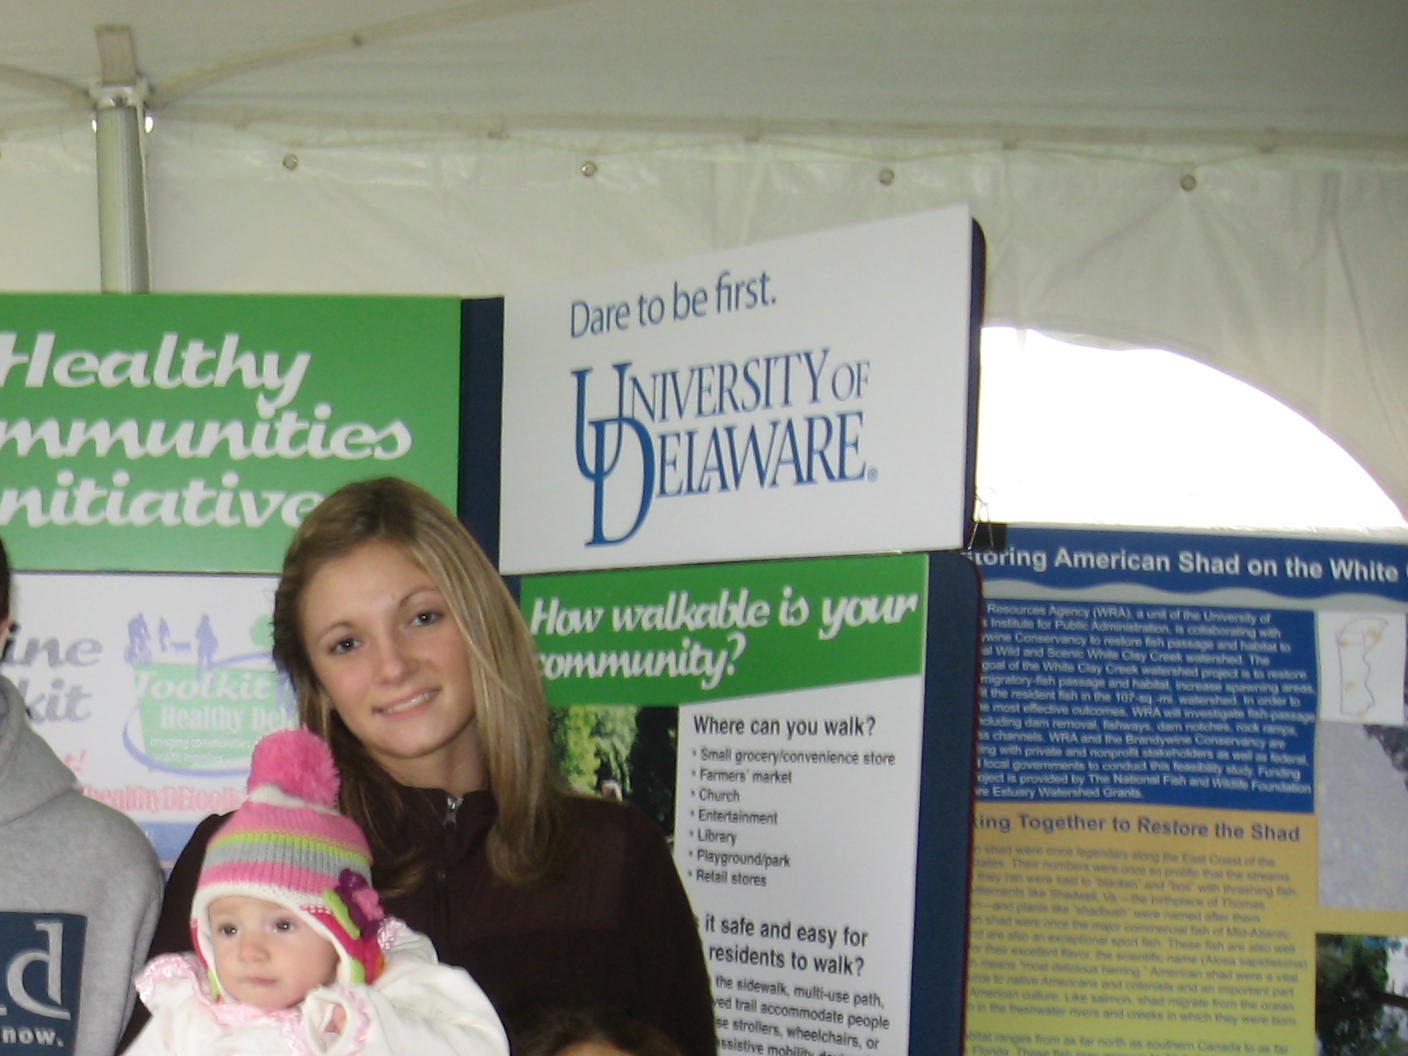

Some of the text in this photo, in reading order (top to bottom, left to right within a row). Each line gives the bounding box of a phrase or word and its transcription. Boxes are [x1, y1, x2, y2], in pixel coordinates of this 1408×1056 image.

[570, 270, 777, 339] Dare to be first.
[1054, 545, 1171, 572] American
[1178, 551, 1240, 575] Shad
[1247, 558, 1278, 577] on
[1285, 555, 1323, 579] the
[1329, 557, 1399, 583] White
[531, 586, 919, 641] How walkable is your
[987, 604, 1046, 616] Resources
[1049, 604, 1090, 619] Agency
[134, 668, 271, 702] Toolkit
[160, 705, 244, 733] Healthy
[694, 715, 876, 740] Where can you walk?
[700, 747, 896, 766] Small grocery/convenience store
[752, 769, 793, 784] market
[699, 788, 740, 802] Church
[698, 808, 778, 825] Entertainment
[1018, 813, 1106, 833] Together
[1112, 816, 1130, 832] to
[1137, 816, 1209, 838] Restore
[1214, 821, 1244, 838] the
[1251, 823, 1301, 842] Shad
[697, 829, 737, 847] Library
[697, 848, 790, 869] Playground/park
[696, 869, 767, 888] Retail stores
[705, 913, 869, 949] it safe and easy for
[709, 944, 865, 977] residents to walk?
[715, 975, 885, 1010] the sidewalk, multi-use path,
[735, 998, 757, 1013] trail
[760, 1003, 843, 1024] accommodate
[847, 1013, 890, 1031] people
[732, 1018, 784, 1038] strollers,
[786, 1026, 862, 1050] wheelchairs,
[865, 1038, 880, 1050] or
